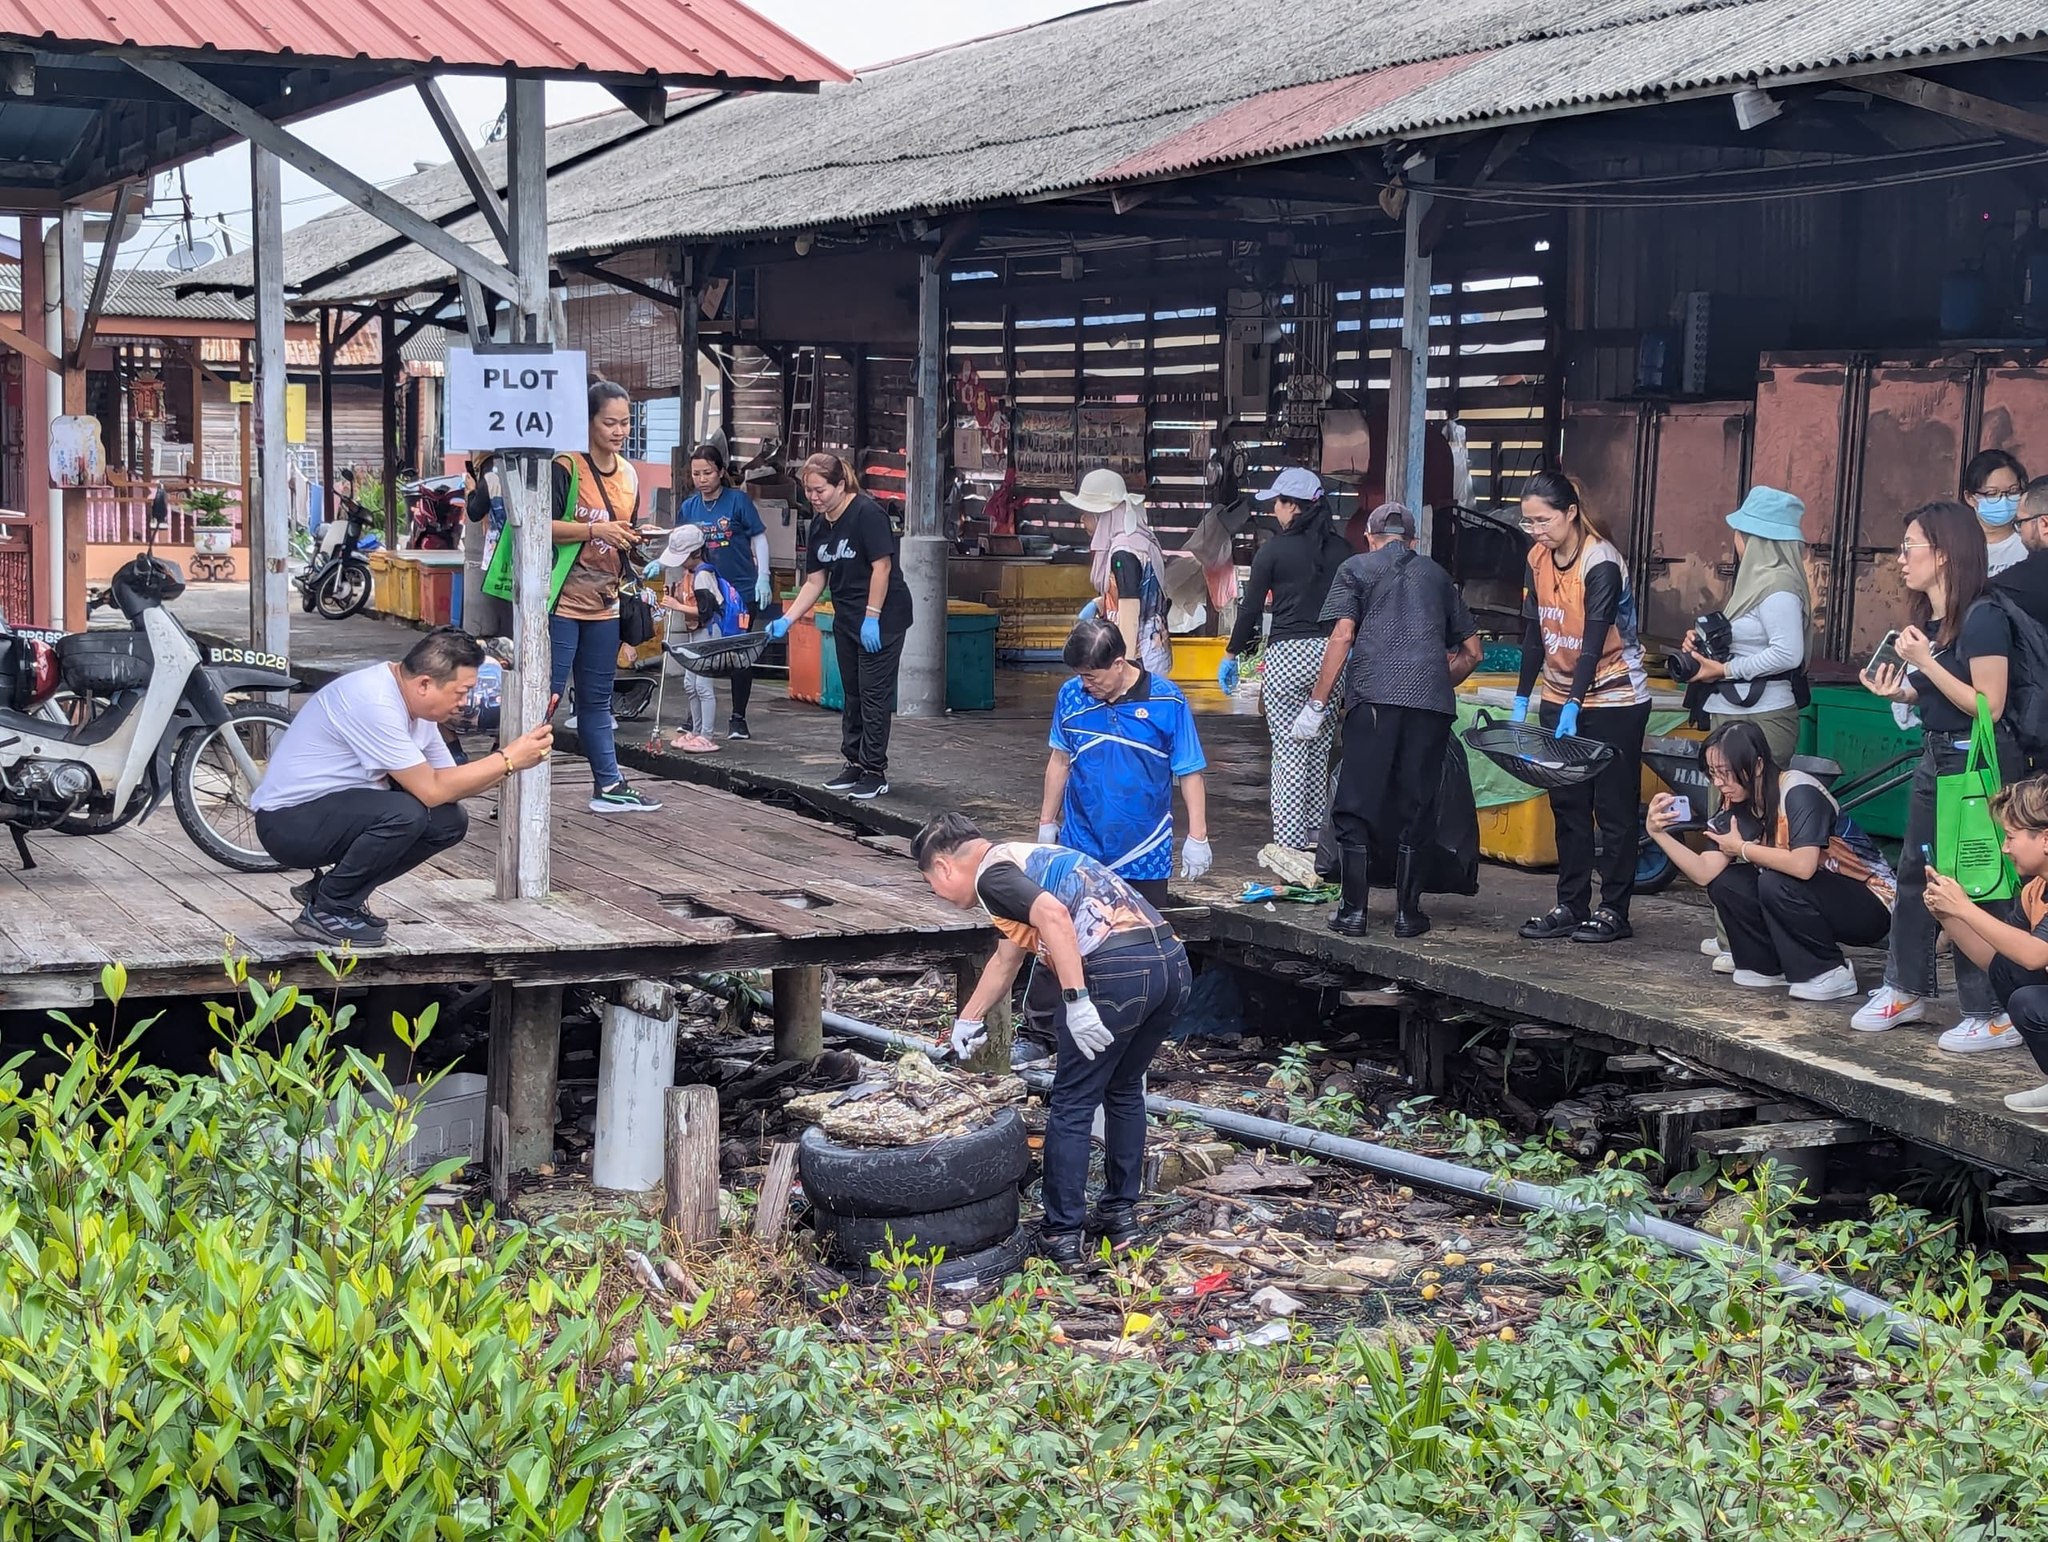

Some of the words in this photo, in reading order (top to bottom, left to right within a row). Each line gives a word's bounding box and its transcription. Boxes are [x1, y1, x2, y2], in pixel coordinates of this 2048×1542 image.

[483, 368, 558, 390] PLOT
[488, 410, 505, 431] 2
[515, 410, 554, 438] (A)
[210, 647, 287, 670] BCS6028
